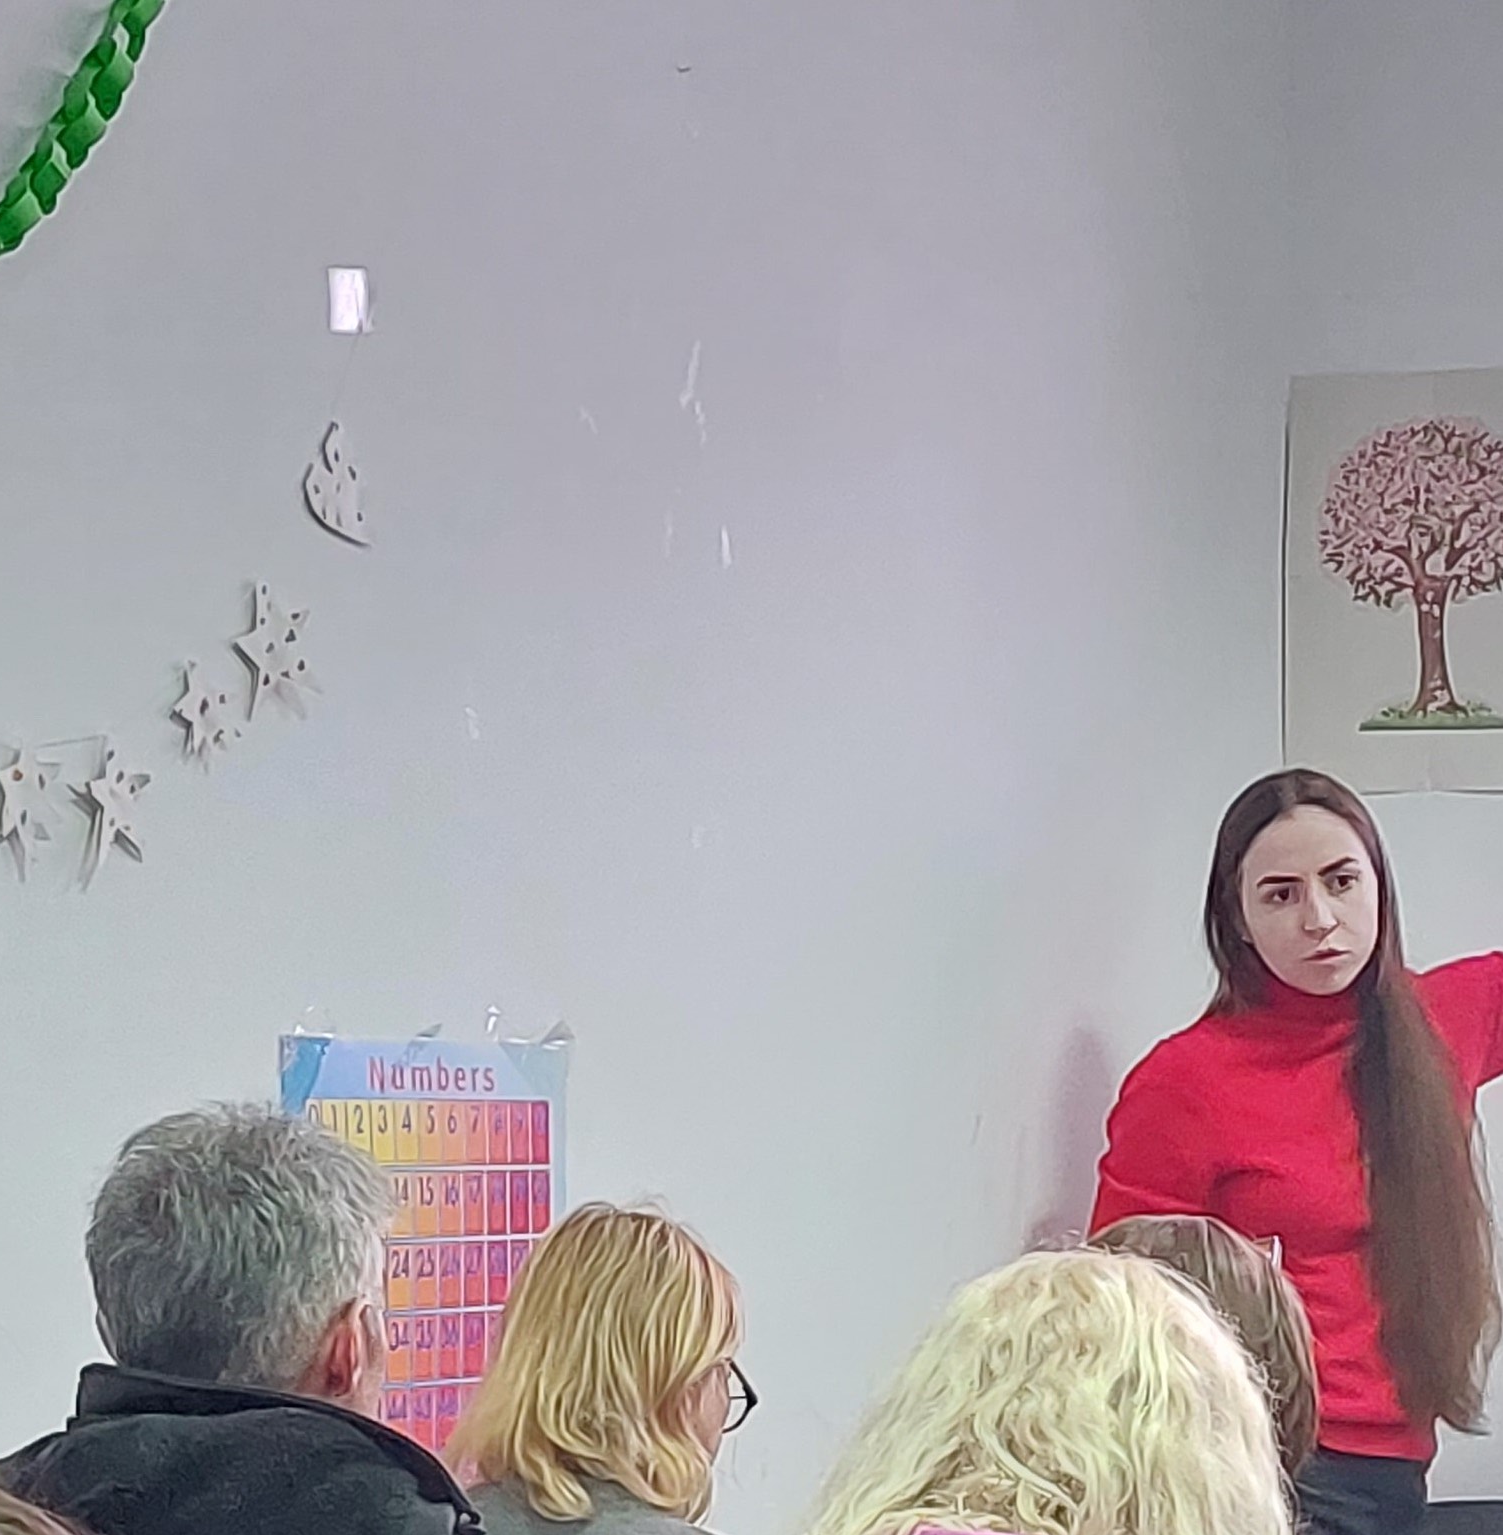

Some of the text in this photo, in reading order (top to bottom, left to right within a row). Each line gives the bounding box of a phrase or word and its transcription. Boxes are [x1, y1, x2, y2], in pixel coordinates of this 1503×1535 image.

[369, 1055, 496, 1093] Numbers
[353, 1104, 365, 1134] 2
[377, 1104, 389, 1134] 3
[401, 1104, 413, 1134] 4
[427, 1104, 436, 1134] 5
[447, 1104, 458, 1134] 6
[470, 1104, 482, 1134] 7
[418, 1175, 434, 1206] 15
[391, 1247, 410, 1278] 24
